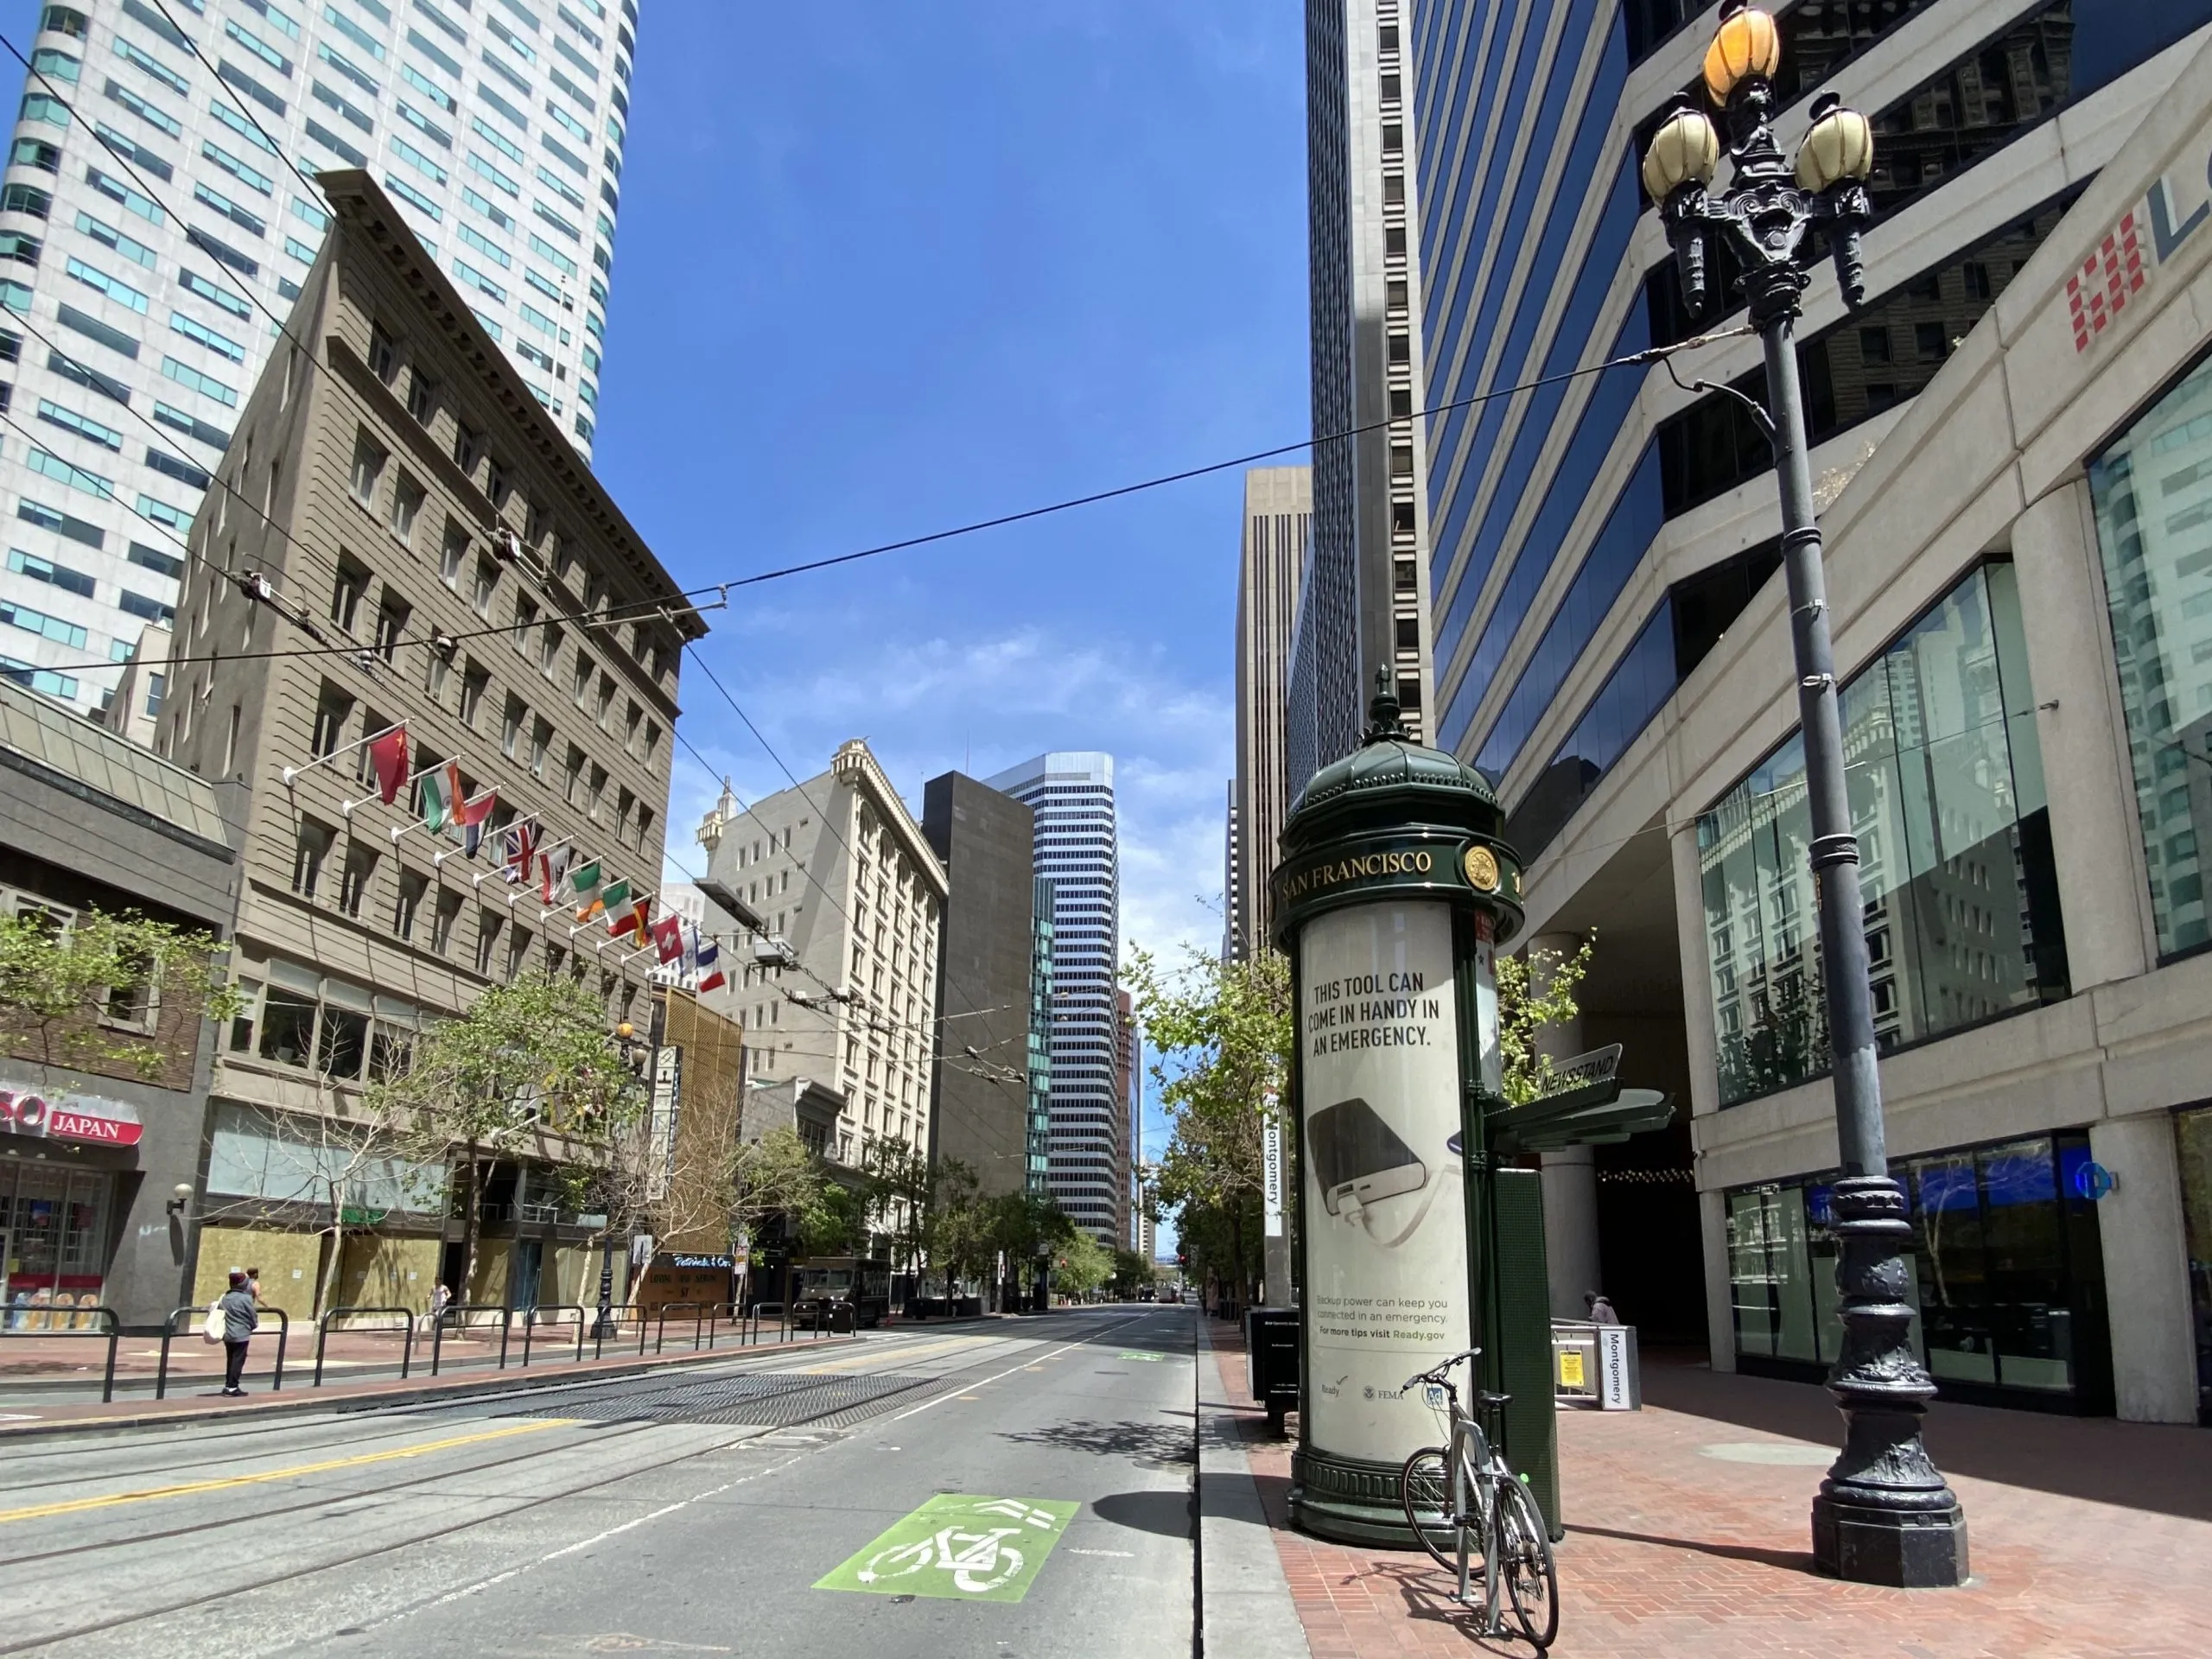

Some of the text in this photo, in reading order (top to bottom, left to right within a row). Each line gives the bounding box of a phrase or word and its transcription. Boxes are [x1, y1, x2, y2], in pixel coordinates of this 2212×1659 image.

[1282, 851, 1432, 902] SAN FRANCISCO
[1314, 972, 1424, 1005] THIS TOOL CAN
[1307, 999, 1440, 1034] COME IN HANDY IN
[1313, 1026, 1431, 1058] AN EMERGENCY.
[1541, 1055, 1614, 1093] NEWSSTAND
[54, 1115, 120, 1139] JAPAN
[1317, 1295, 1448, 1309] Backup power can keep you
[1317, 1310, 1448, 1325] connected in an emergency.
[1319, 1325, 1445, 1341] For more tips visit Ready.gov
[1610, 1333, 1621, 1404] Montgomery
[1321, 1384, 1340, 1397] Ready
[1378, 1390, 1404, 1401] FEMA
